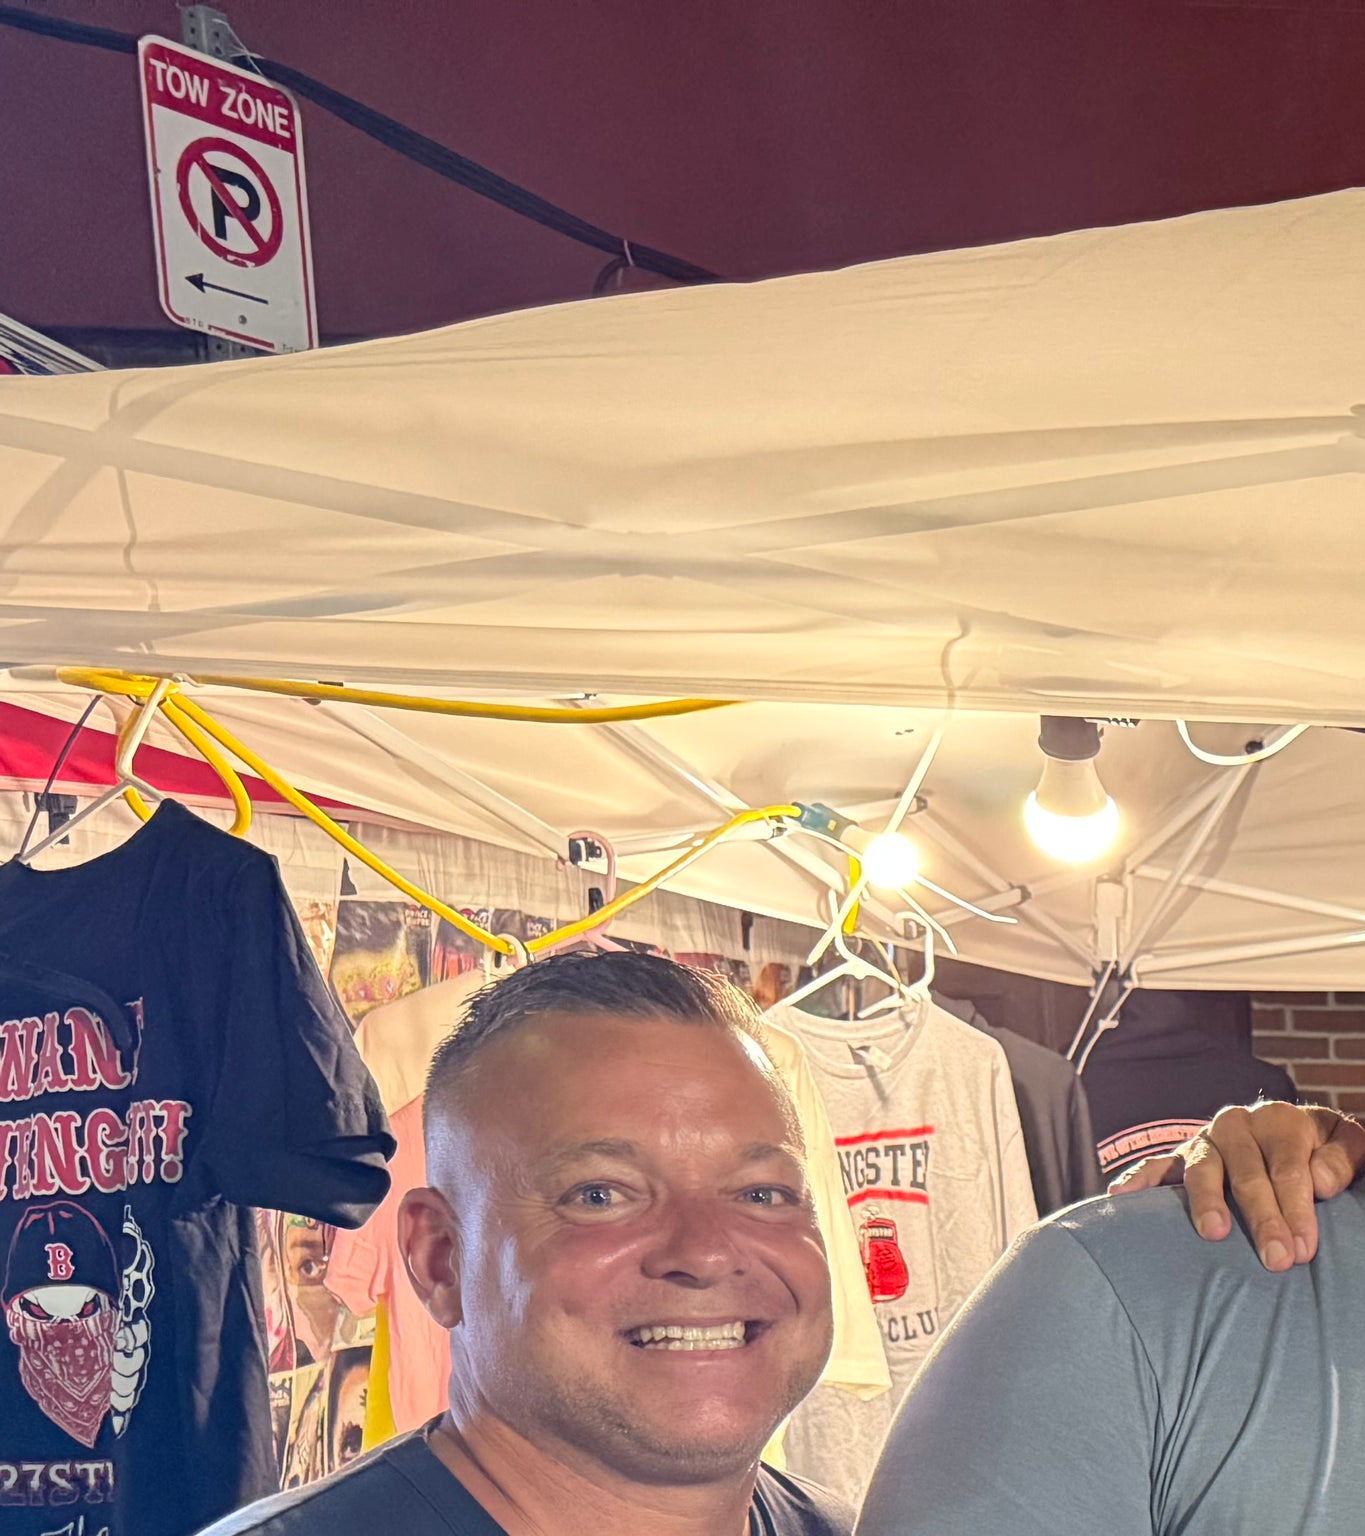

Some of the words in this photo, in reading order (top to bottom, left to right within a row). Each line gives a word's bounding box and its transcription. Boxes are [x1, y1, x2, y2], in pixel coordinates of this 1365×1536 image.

[149, 58, 209, 107] TOW
[219, 84, 291, 138] ZONE
[45, 1242, 75, 1280] B
[887, 1304, 939, 1343] CLU
